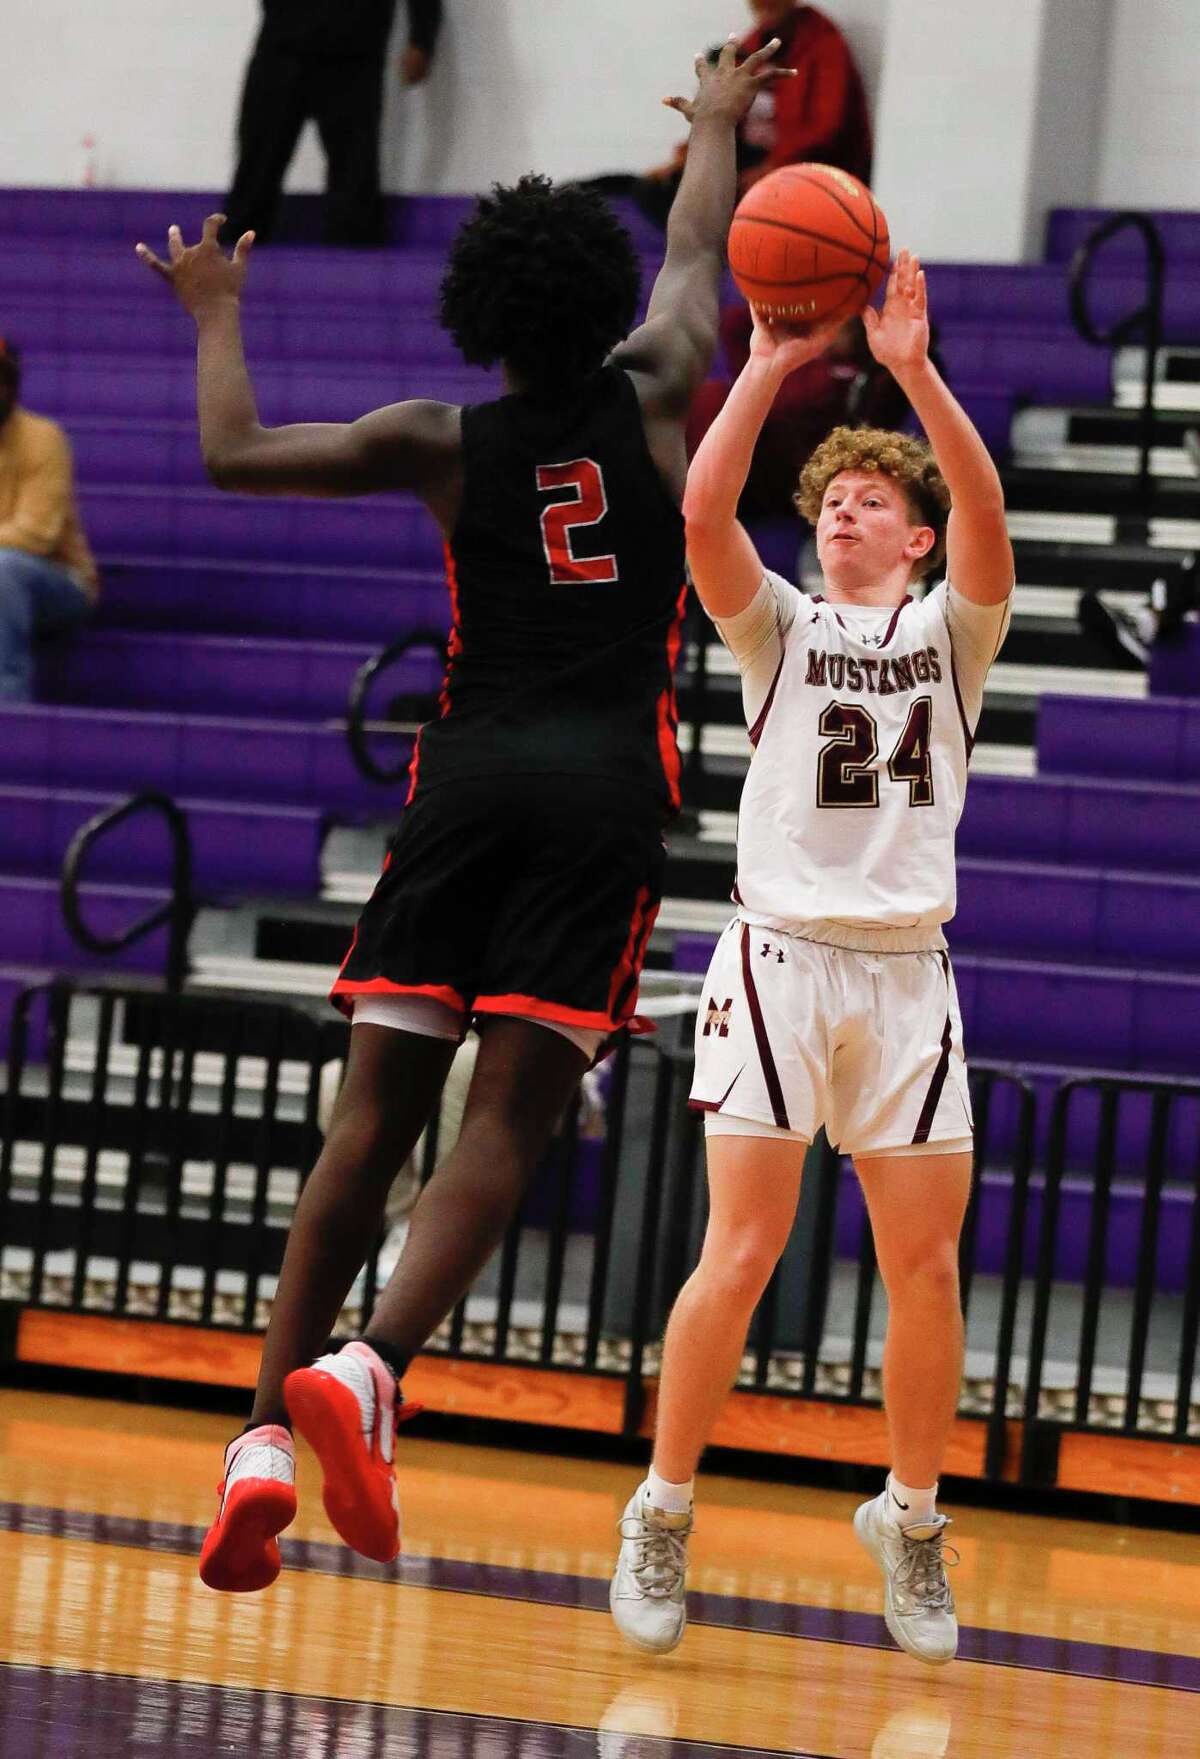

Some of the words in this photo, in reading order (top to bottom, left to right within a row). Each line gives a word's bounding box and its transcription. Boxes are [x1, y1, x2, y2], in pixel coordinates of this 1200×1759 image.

[536, 457, 619, 584] 2
[805, 646, 943, 696] MUSTANGS
[816, 695, 935, 808] 24
[702, 996, 733, 1037] M
